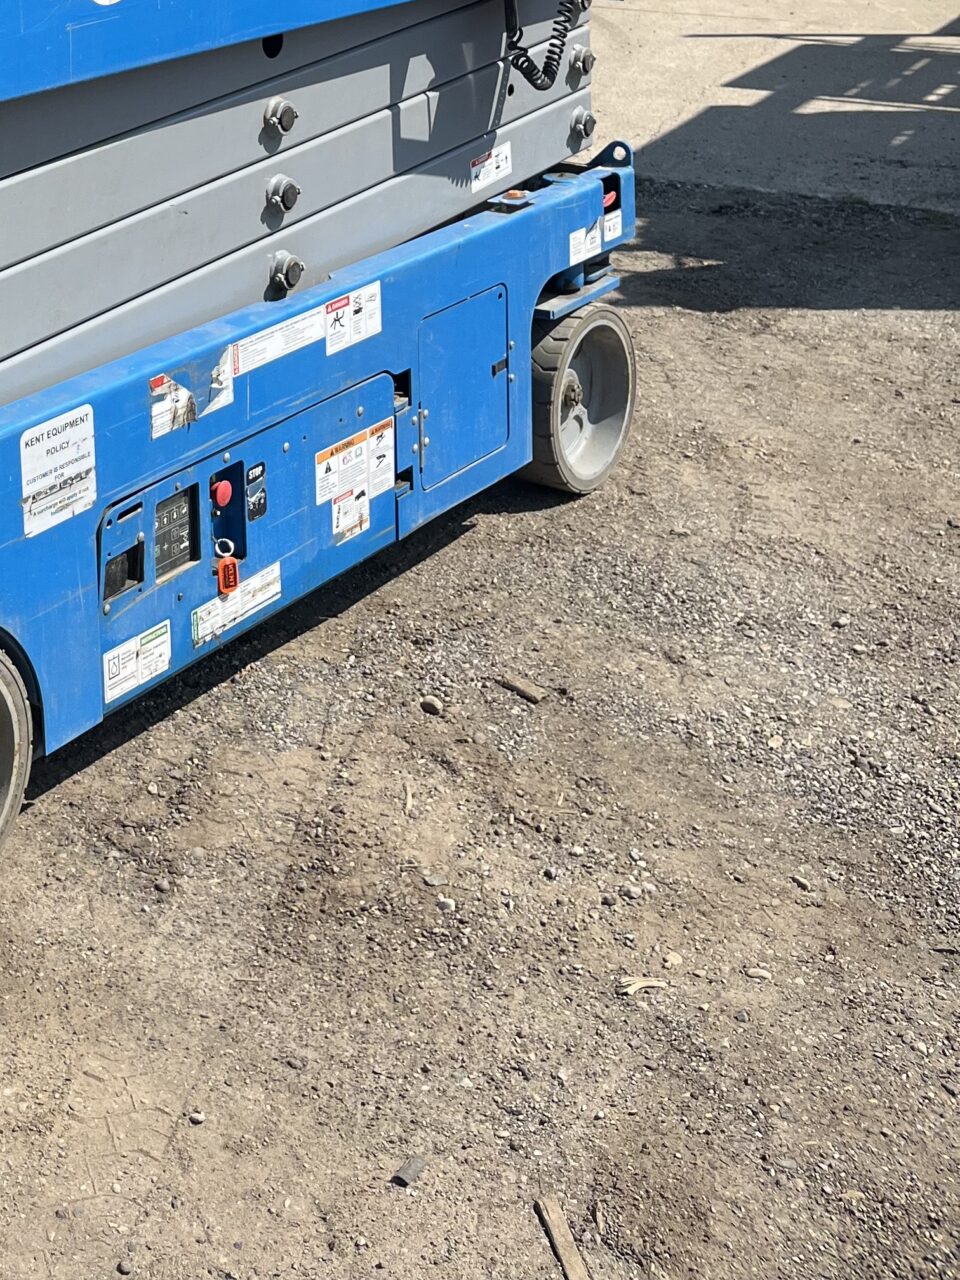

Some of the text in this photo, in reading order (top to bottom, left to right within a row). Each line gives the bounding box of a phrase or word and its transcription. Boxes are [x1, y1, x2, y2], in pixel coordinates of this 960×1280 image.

[24, 413, 90, 449] KENT EQUIPMENT
[46, 440, 70, 457] POLICY
[26, 469, 53, 486] CUSTOMER
[58, 451, 91, 471] RESPONSIBLE
[54, 472, 65, 482] FOR
[248, 465, 263, 480] STOP
